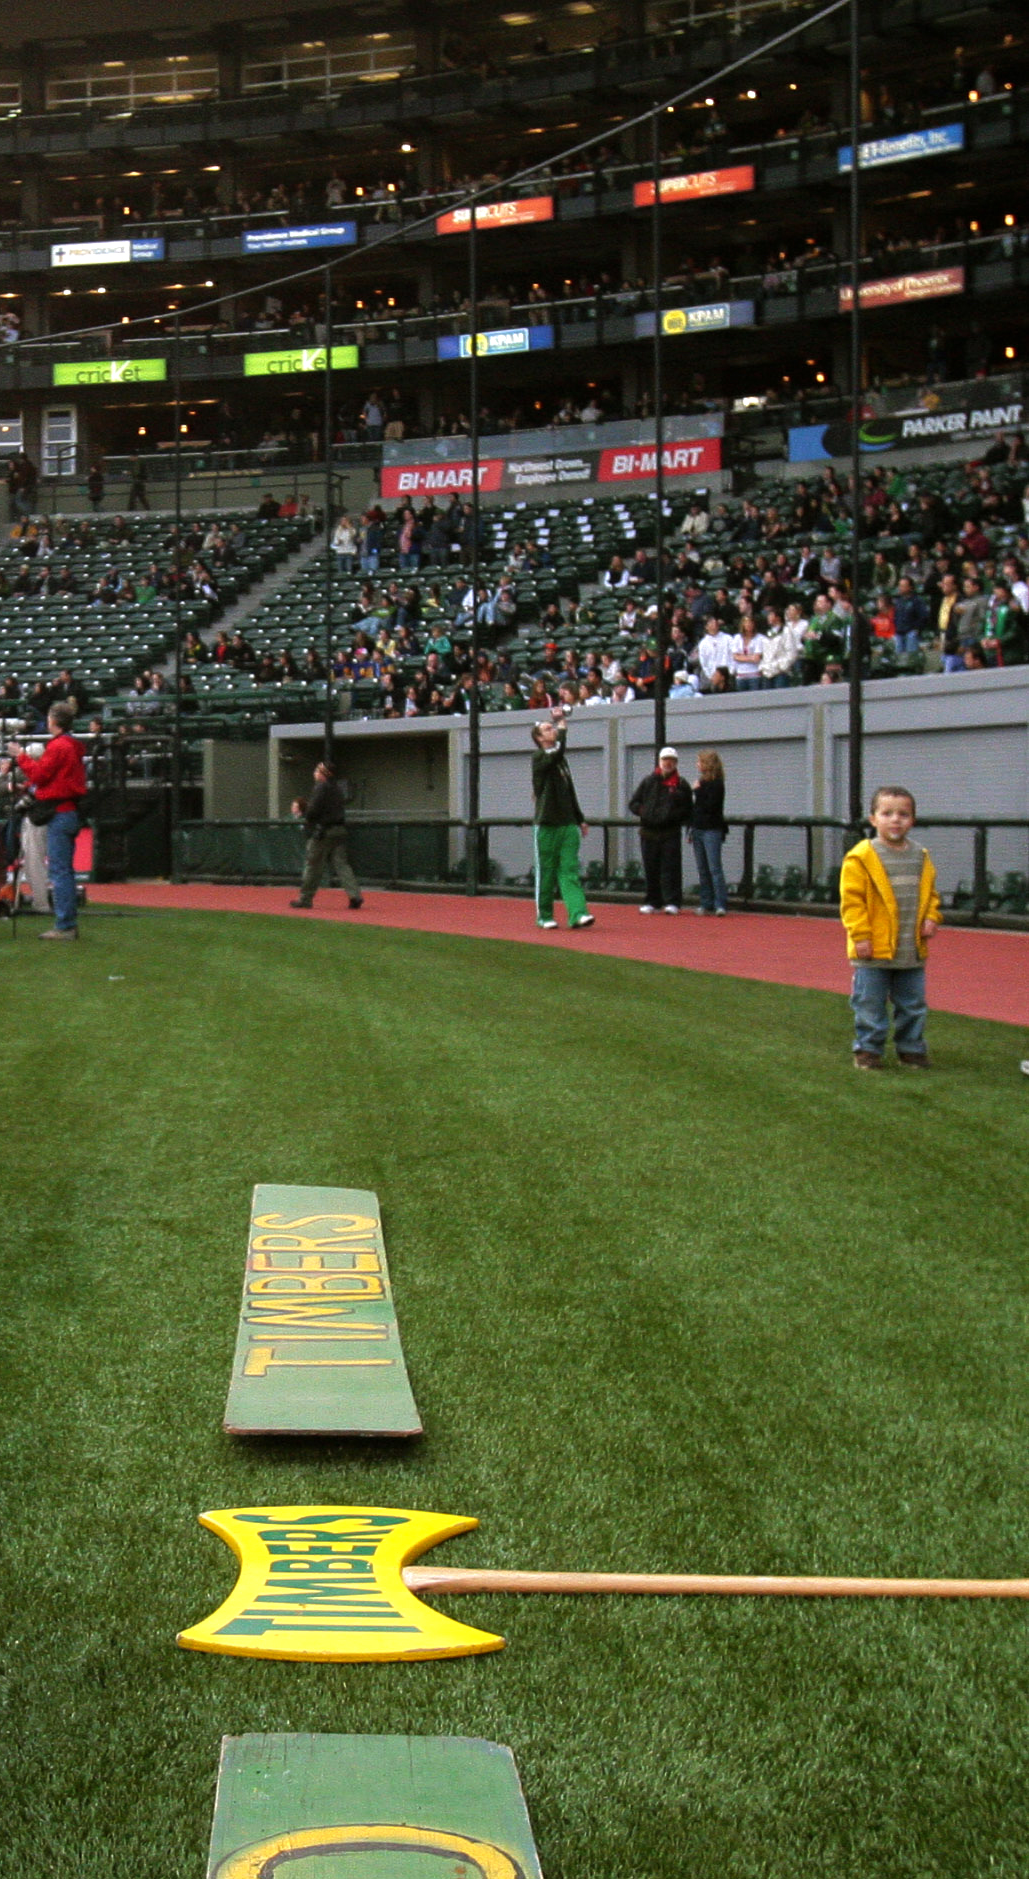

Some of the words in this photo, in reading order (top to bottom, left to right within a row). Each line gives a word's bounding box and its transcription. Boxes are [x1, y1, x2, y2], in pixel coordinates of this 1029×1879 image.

[489, 332, 524, 346] KPAM
[77, 360, 141, 384] cricket
[264, 347, 328, 376] cricke
[901, 413, 967, 438] PARKER
[970, 404, 1023, 428] PAINT
[243, 1213, 395, 1377] TIMBERS
[211, 1514, 423, 1635] TIMBERS
